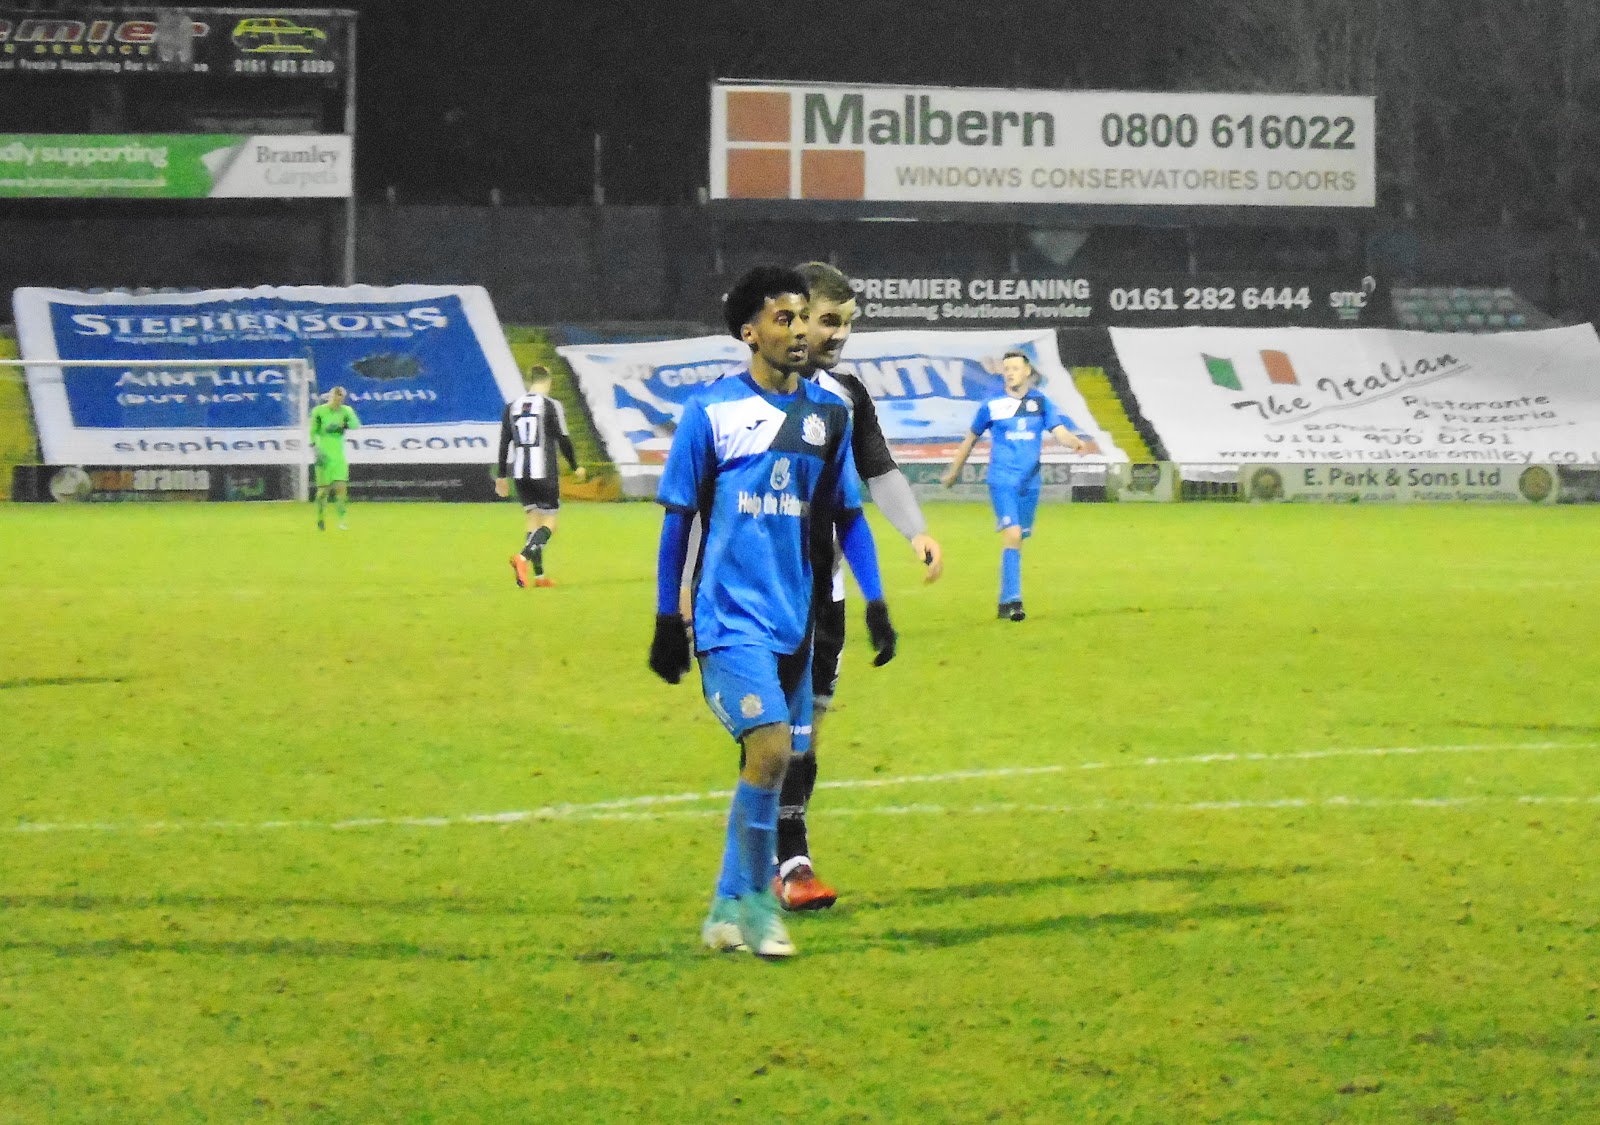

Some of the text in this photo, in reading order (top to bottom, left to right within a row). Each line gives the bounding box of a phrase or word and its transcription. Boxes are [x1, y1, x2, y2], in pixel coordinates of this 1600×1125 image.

[804, 93, 1356, 149] Malbern 0800 616022
[257, 146, 338, 168] Bramley
[896, 166, 1356, 191] WINDOWS CONSERVATORIES DOORS
[848, 279, 1090, 300] PREMIER CLEANING
[1109, 287, 1312, 310] 0161 282 6444
[71, 306, 448, 336] STEPHENSONS
[865, 303, 939, 321] Cleaning
[942, 303, 1021, 318] Solutions
[1023, 303, 1092, 318] Provider
[115, 371, 196, 387] AIM
[114, 436, 488, 454] stephensns.com
[1304, 467, 1501, 486] E. Park & Sons Ltd
